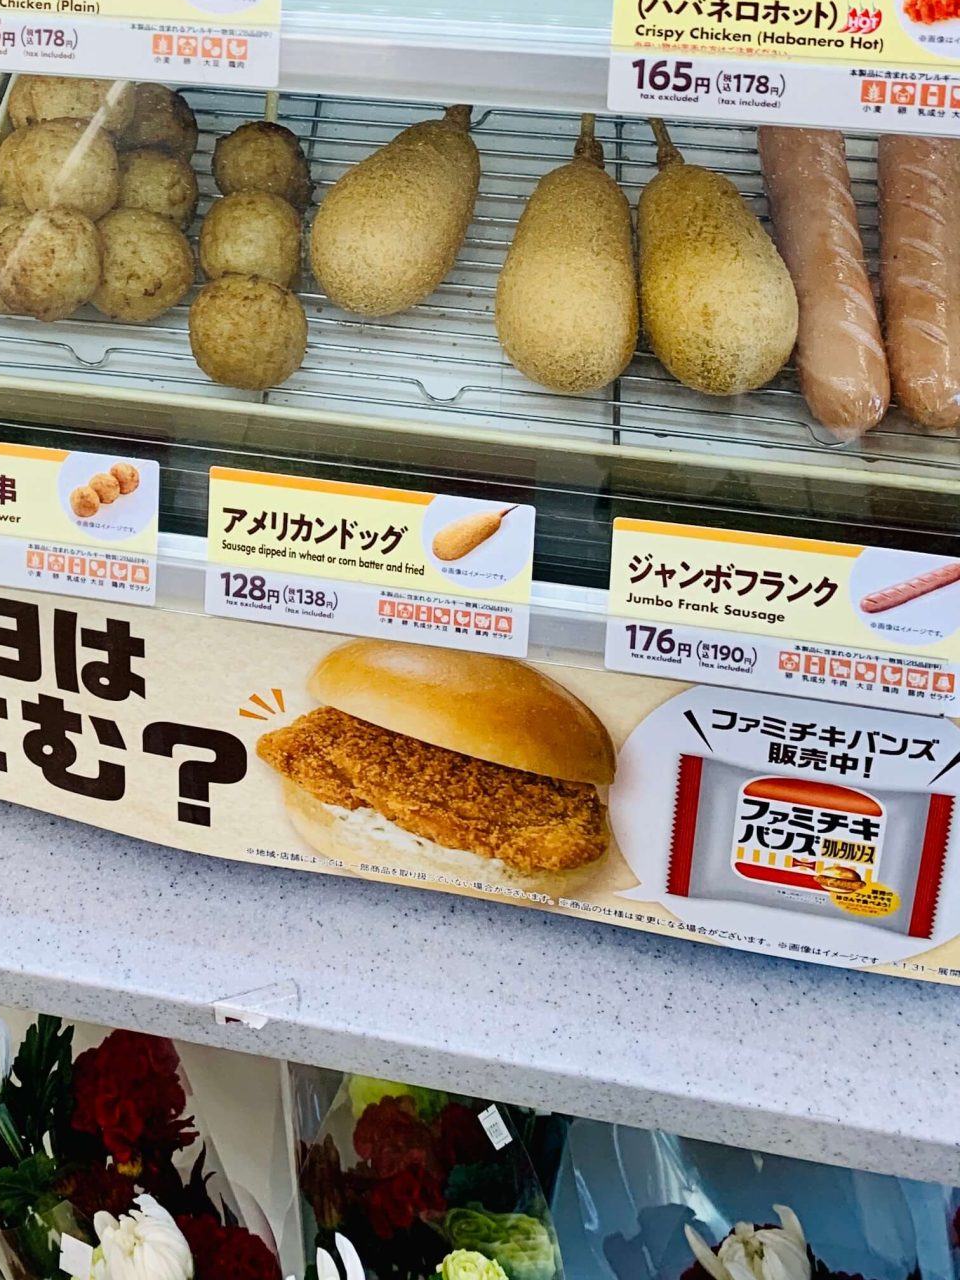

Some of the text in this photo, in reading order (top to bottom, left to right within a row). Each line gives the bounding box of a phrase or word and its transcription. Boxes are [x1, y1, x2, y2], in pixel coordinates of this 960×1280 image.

[56, 0, 101, 15] (Plain)
[846, 12, 881, 31] HOT
[635, 24, 885, 54] Crispy Chicken (Habanero Hot)
[632, 58, 711, 95] 165円
[657, 93, 700, 104] excluded
[221, 506, 409, 556] アメリカンドッグ
[221, 539, 426, 577] Sausage dipped in wheat or corn batter and fried
[220, 571, 281, 605] 128円
[626, 552, 840, 609] ジャンボフランク
[626, 591, 786, 625] Jumbo Frank Sausage
[625, 623, 692, 660] 176円
[711, 708, 940, 762] ファミチキバンズ
[768, 741, 875, 780] 販売中!
[740, 798, 881, 842] ファミチキ
[738, 823, 821, 858] バンズ
[821, 838, 877, 866] タルタルソース
